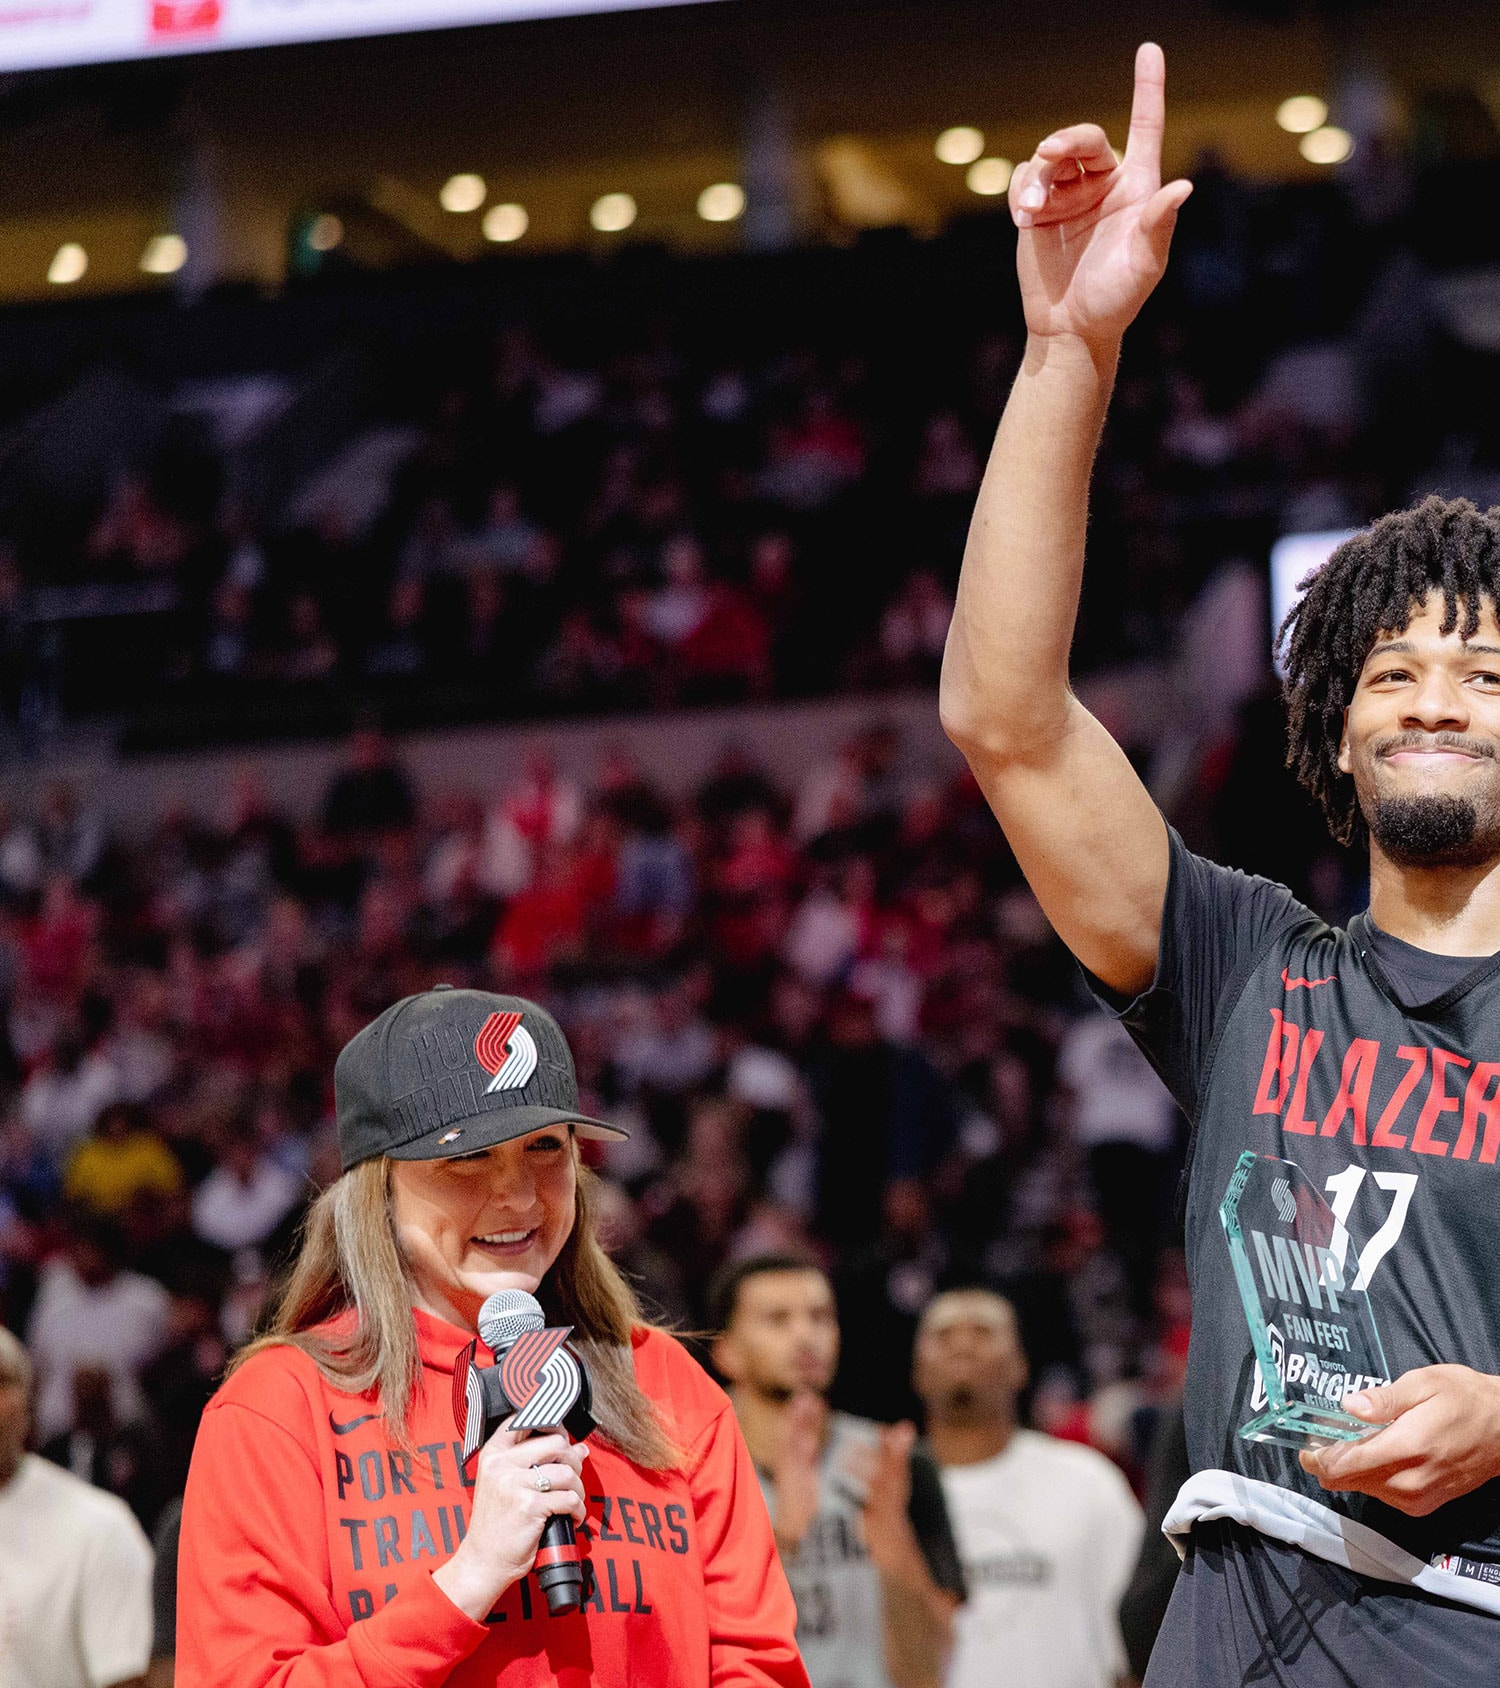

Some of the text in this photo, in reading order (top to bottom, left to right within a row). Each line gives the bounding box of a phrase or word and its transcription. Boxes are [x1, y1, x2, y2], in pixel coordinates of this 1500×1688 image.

[1319, 1164, 1419, 1291] 17
[1251, 1229, 1345, 1314] MVP
[1283, 1313, 1351, 1352] FAN FEST
[1320, 1359, 1347, 1373] TOYOTA
[335, 1441, 477, 1501] PORTL
[1465, 1563, 1475, 1576] M
